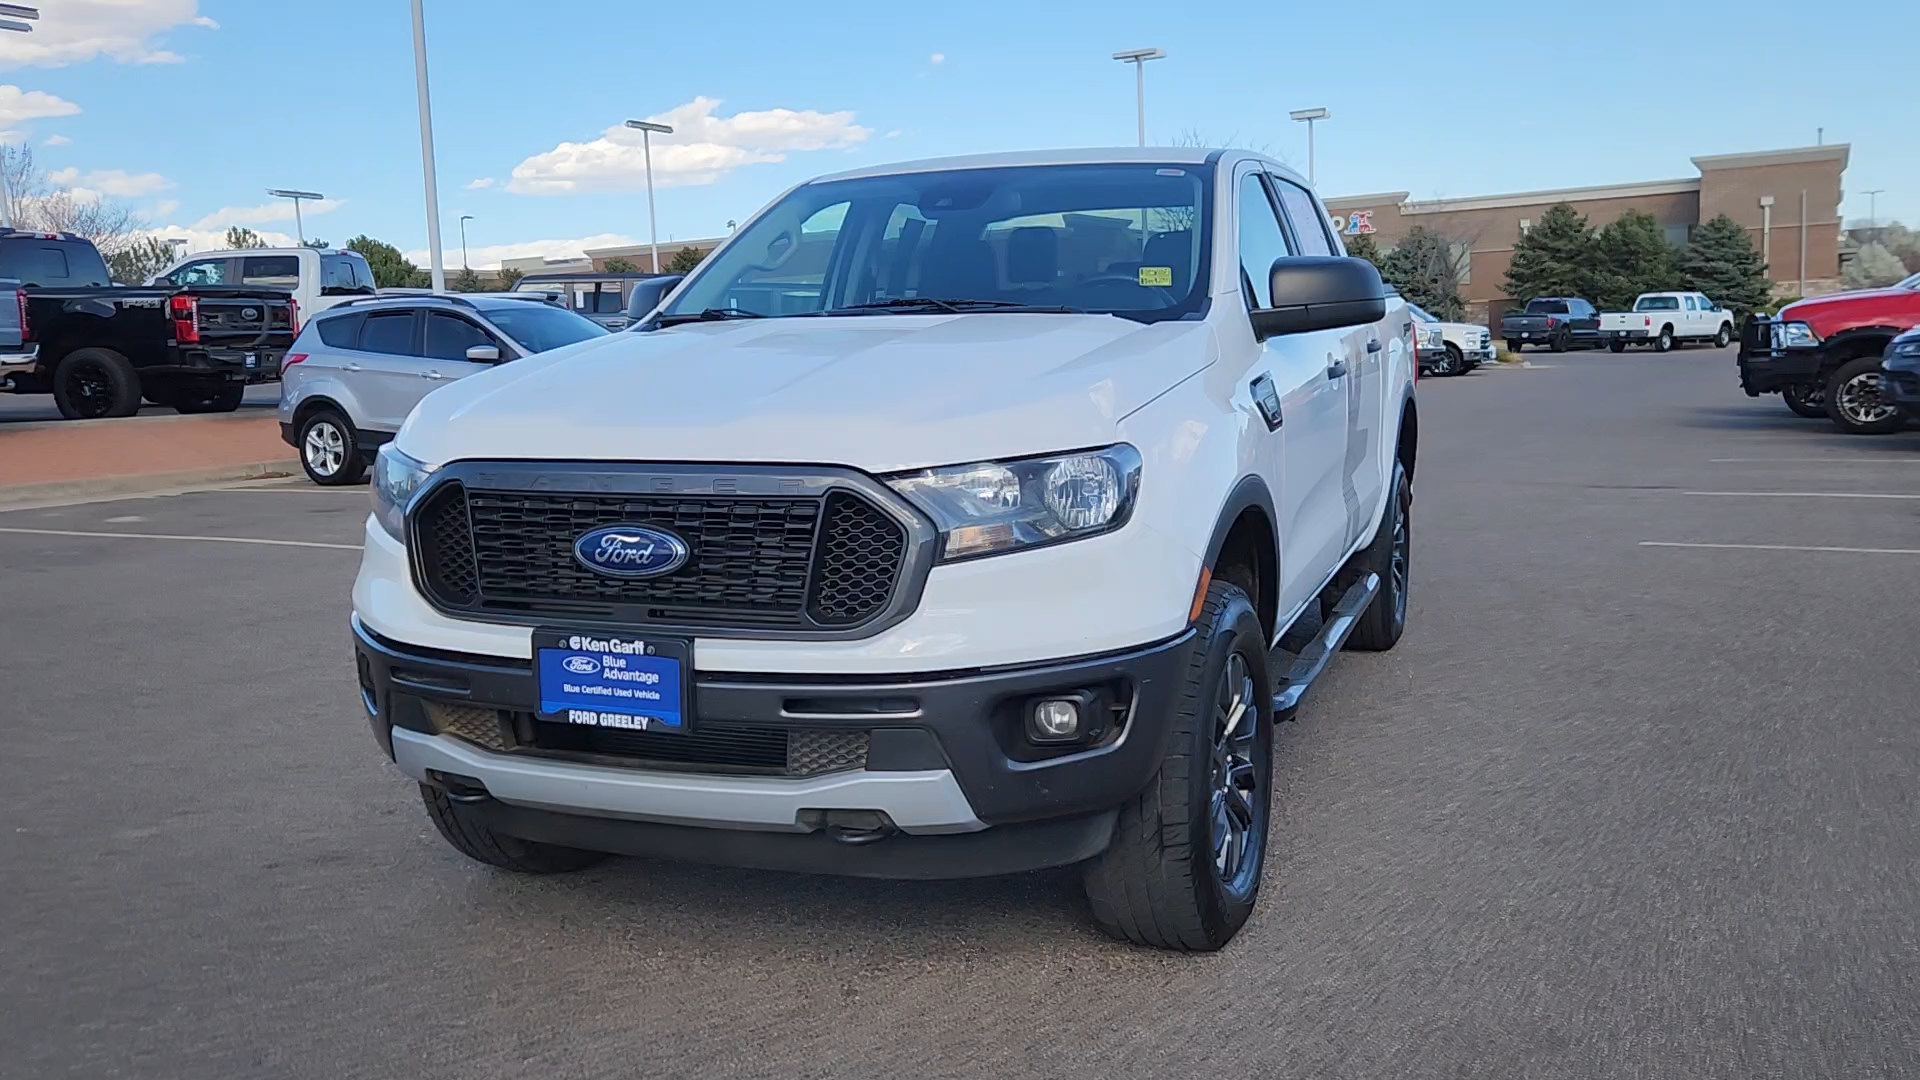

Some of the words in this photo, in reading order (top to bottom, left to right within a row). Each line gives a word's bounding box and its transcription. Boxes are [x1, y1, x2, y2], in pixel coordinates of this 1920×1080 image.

[594, 534, 655, 564] Ford
[569, 658, 594, 671] Ford
[602, 655, 627, 668] Blue
[602, 668, 660, 685] Advantage
[563, 684, 580, 693] Blue
[581, 685, 612, 696] Certified
[613, 688, 633, 698] Used
[633, 689, 660, 700] Vehicle
[568, 709, 598, 725] FORD
[599, 713, 649, 730] GREELEY
